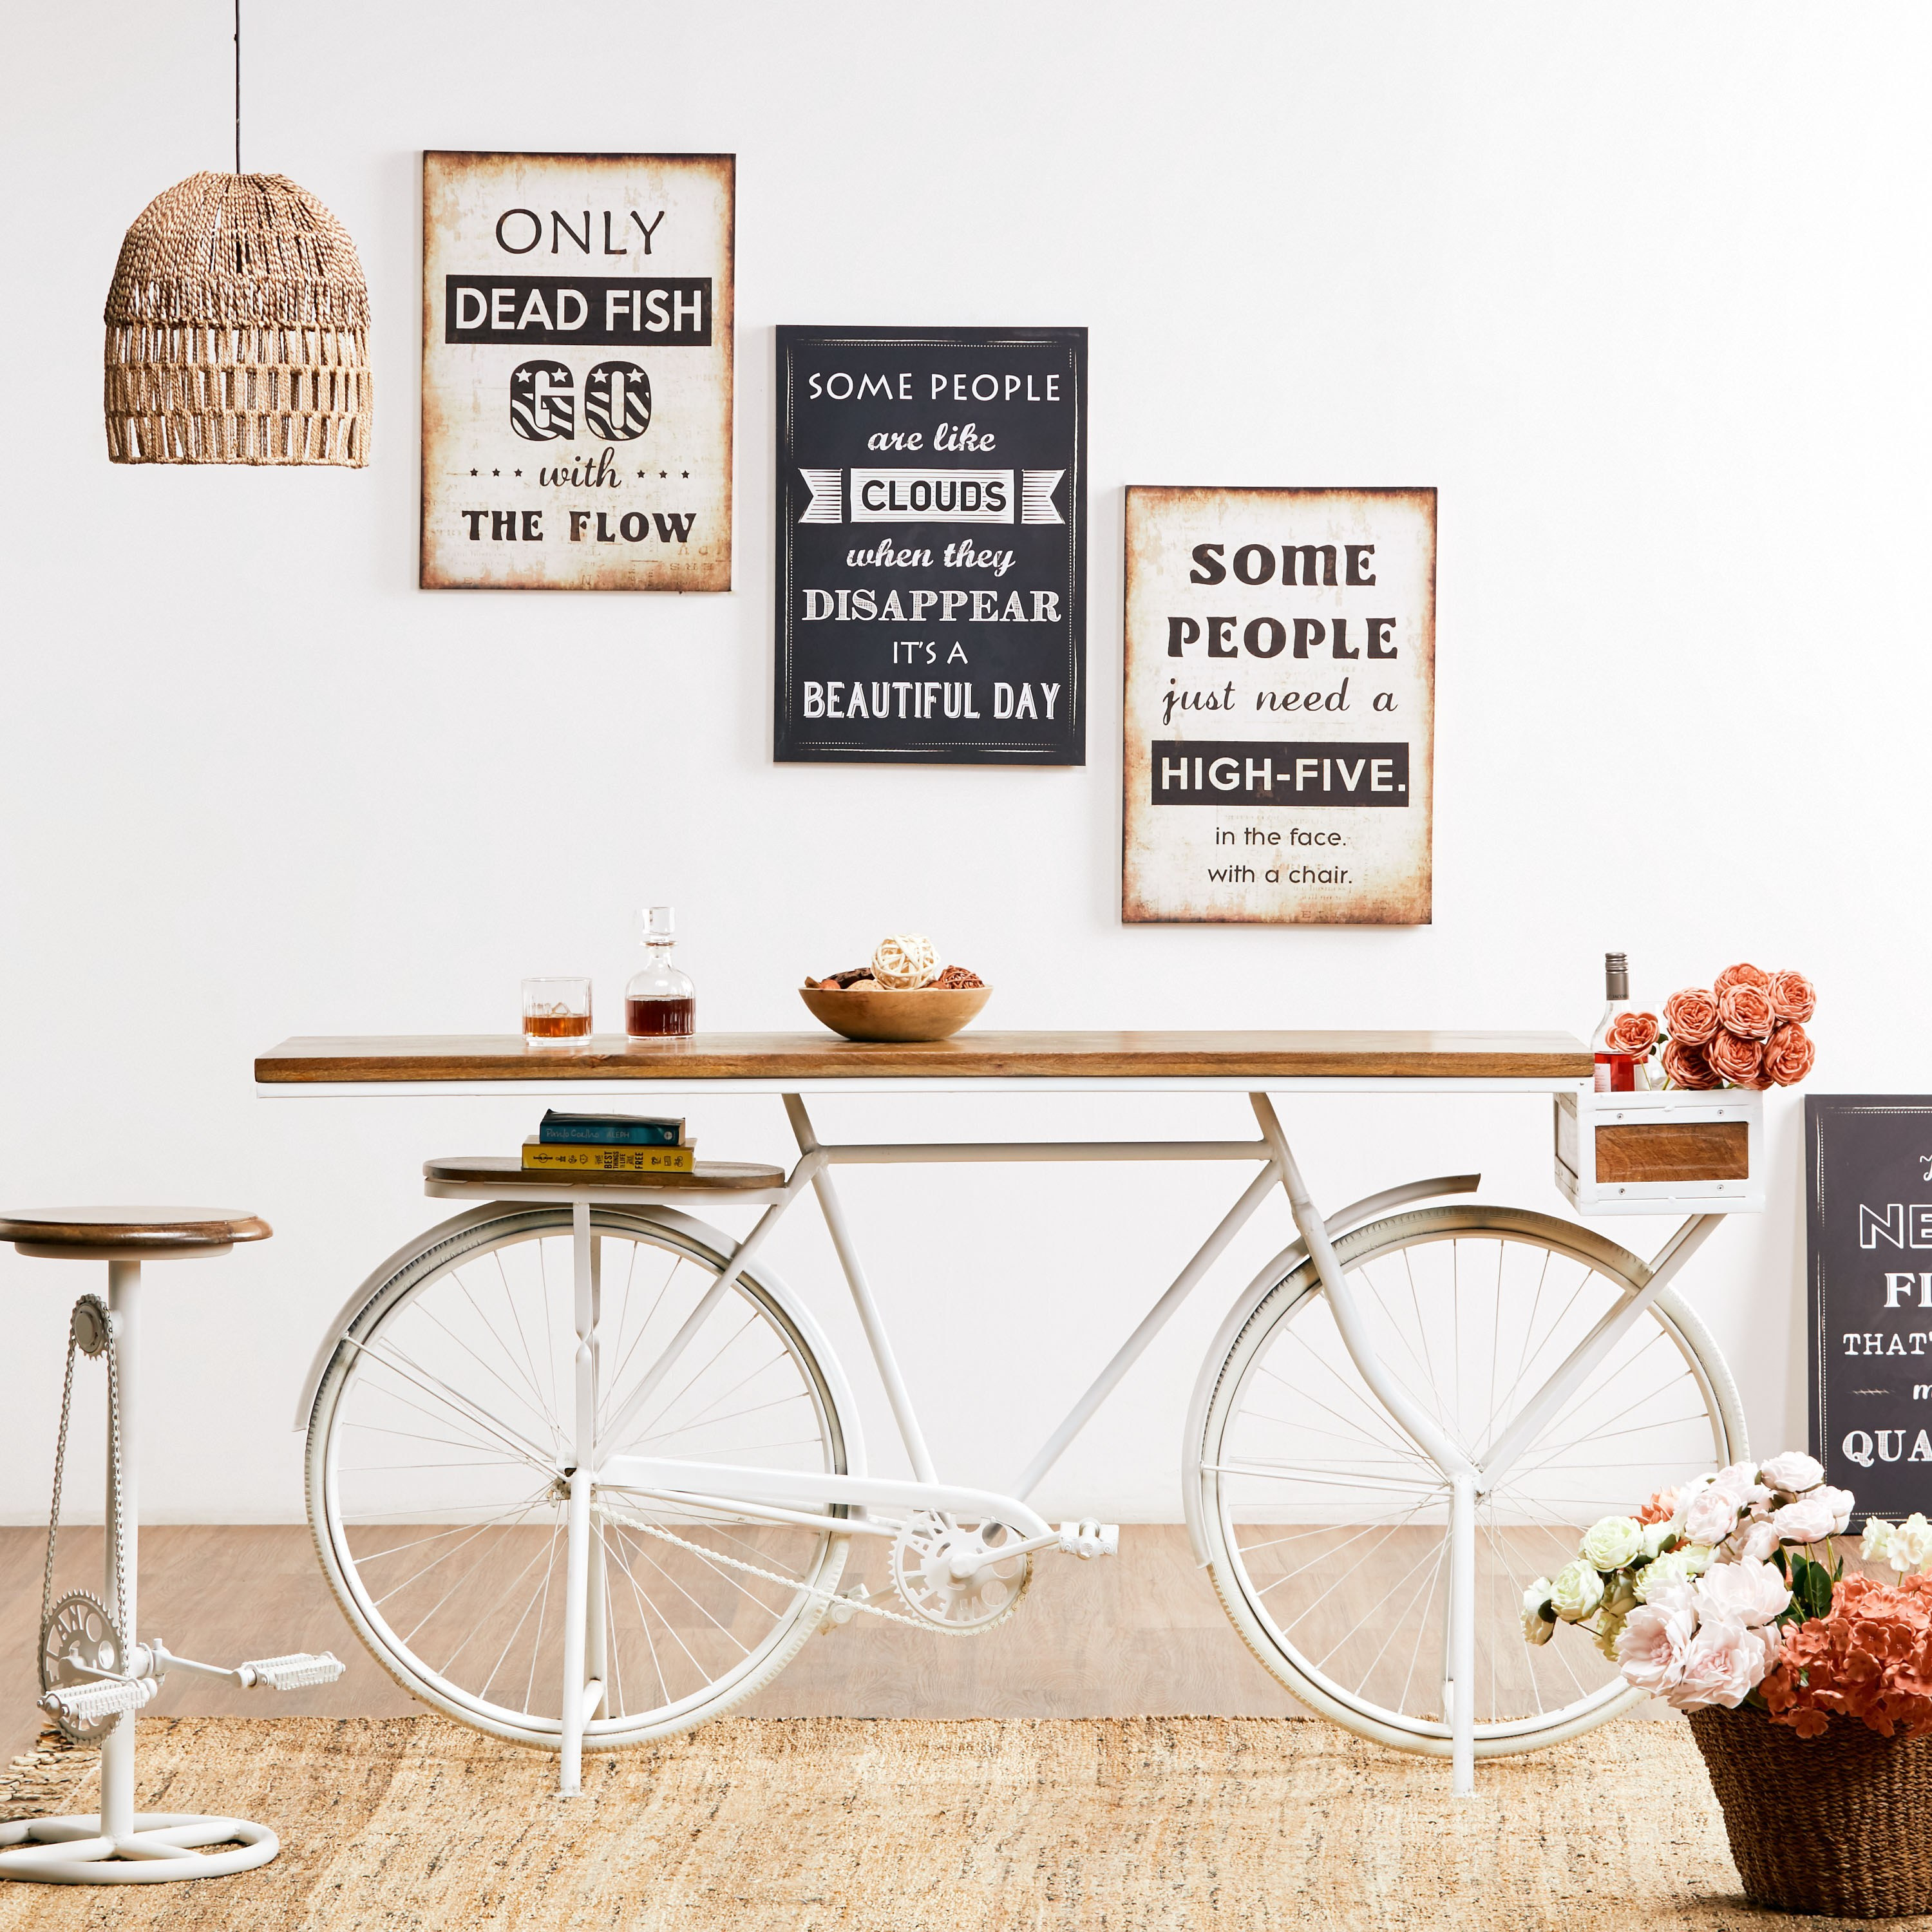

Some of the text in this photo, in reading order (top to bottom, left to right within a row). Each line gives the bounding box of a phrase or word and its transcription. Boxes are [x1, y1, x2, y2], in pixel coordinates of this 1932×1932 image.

[495, 208, 665, 255] ONLY
[456, 287, 701, 332] DEAD FISH
[509, 359, 652, 442] GO
[808, 372, 1060, 401] SOME PEOPLE
[867, 422, 996, 452] are like
[540, 446, 622, 488] with
[861, 480, 1007, 513] CLOUDS
[461, 510, 544, 542] THE
[569, 511, 697, 544] FLOW
[846, 538, 1016, 577] when they
[1189, 544, 1376, 586] SOME
[801, 589, 1061, 622] DISAPPEAR
[893, 641, 969, 665] IT'S A
[1168, 616, 1398, 660] PEOPLE
[803, 681, 1061, 720] BEAUTIFUL DAY
[1162, 677, 1398, 726] just need a
[1162, 757, 1406, 791] HIGH-FIVE.
[1215, 827, 1347, 847] in the face.
[1208, 865, 1353, 884] with a chair.
[606, 1130, 630, 1139] ALEPH
[603, 1151, 613, 1170] BEST
[634, 1151, 644, 1170] FREE
